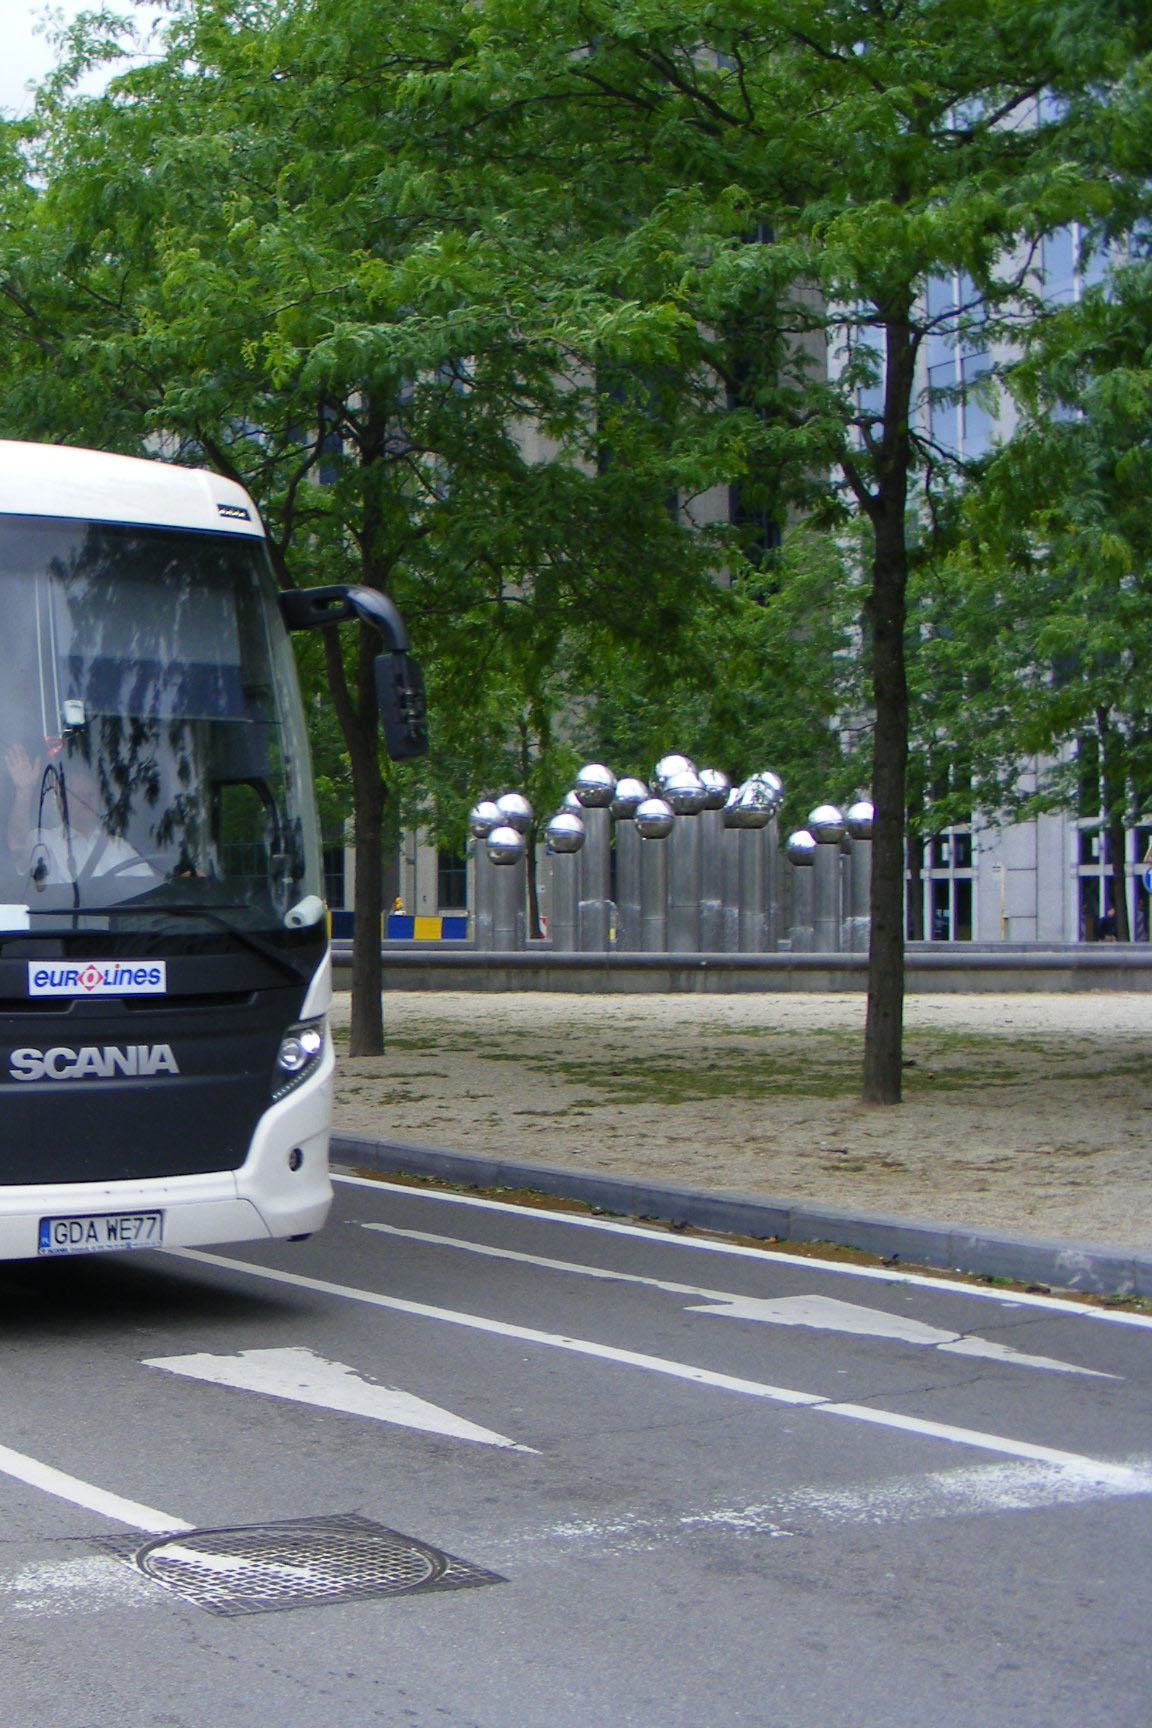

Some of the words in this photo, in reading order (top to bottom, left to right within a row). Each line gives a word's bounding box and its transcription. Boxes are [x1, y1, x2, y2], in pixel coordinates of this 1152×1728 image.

[9, 1044, 180, 1081] SCANIA
[54, 1220, 98, 1245] GDA
[106, 1217, 158, 1242] WE77
